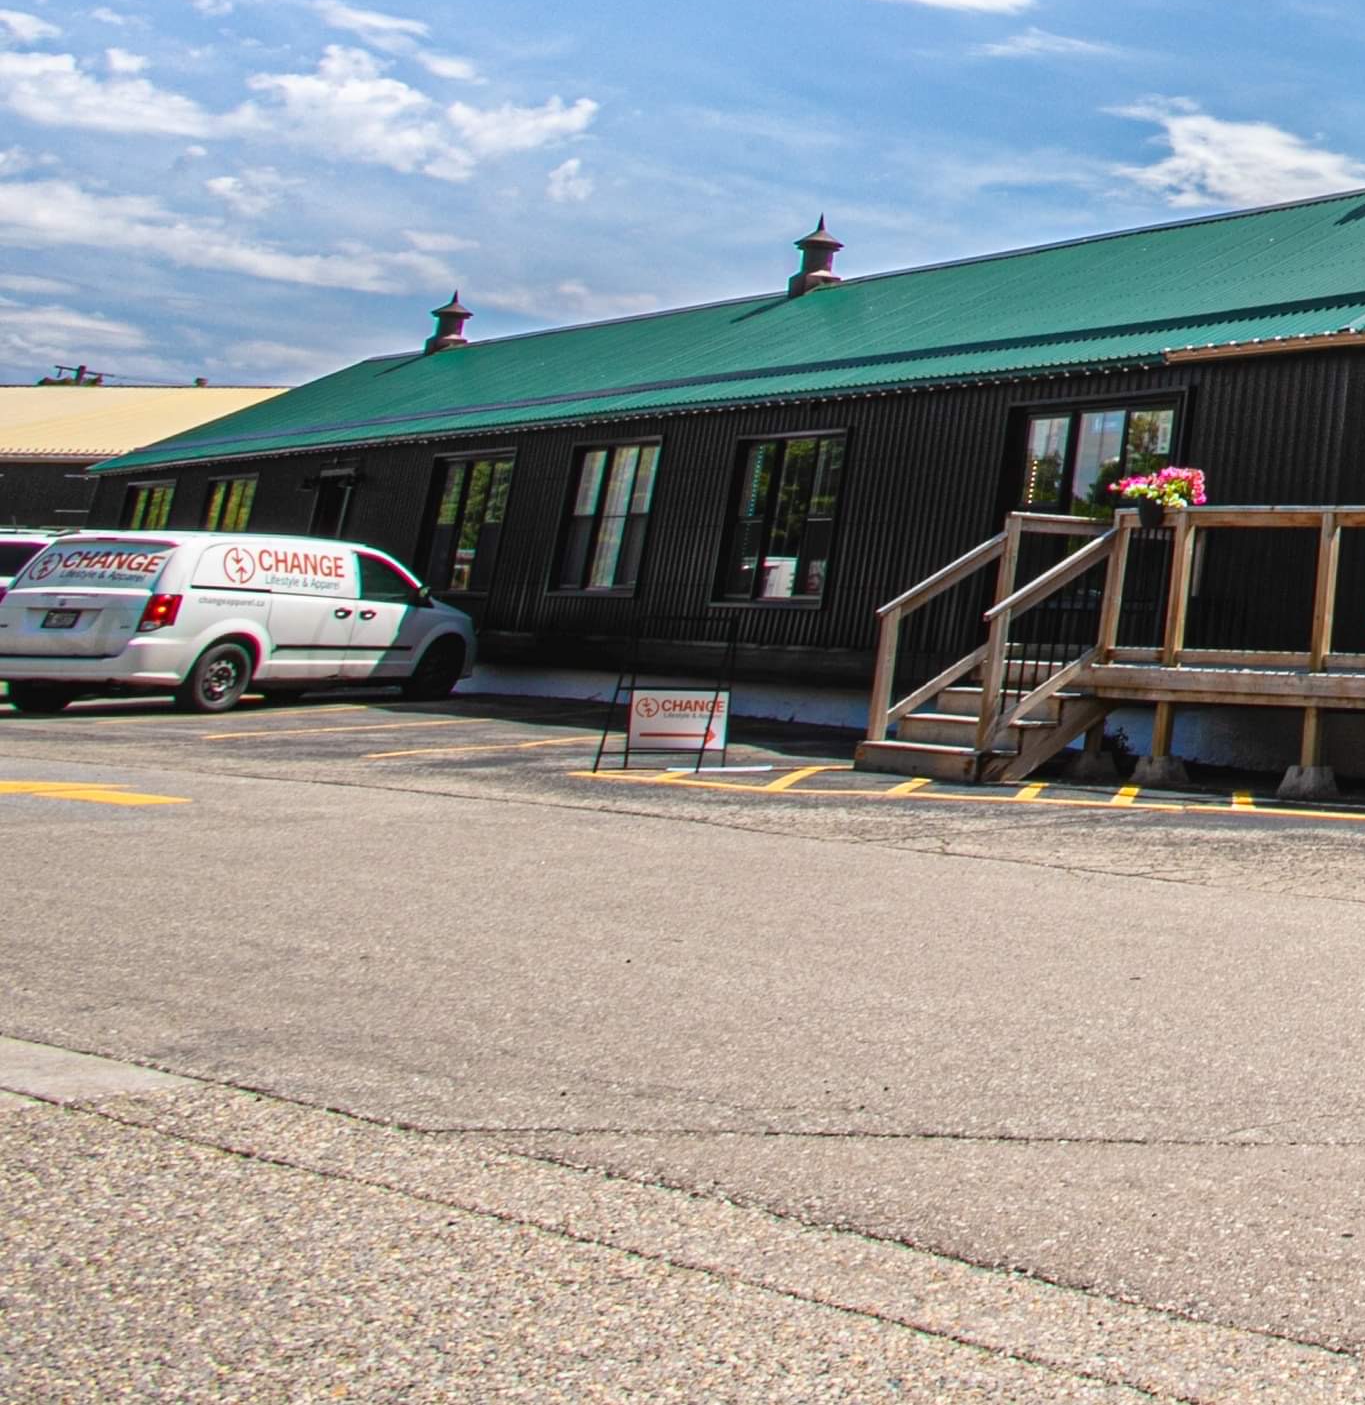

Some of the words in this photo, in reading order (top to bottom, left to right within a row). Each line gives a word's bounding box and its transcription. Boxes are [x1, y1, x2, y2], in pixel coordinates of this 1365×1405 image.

[62, 551, 165, 573] CHANGE
[259, 549, 345, 578] CHANGE
[265, 574, 299, 589] Lifestyle
[302, 578, 309, 588] &
[311, 578, 341, 591] Apparel
[661, 699, 725, 713] CHANGE
